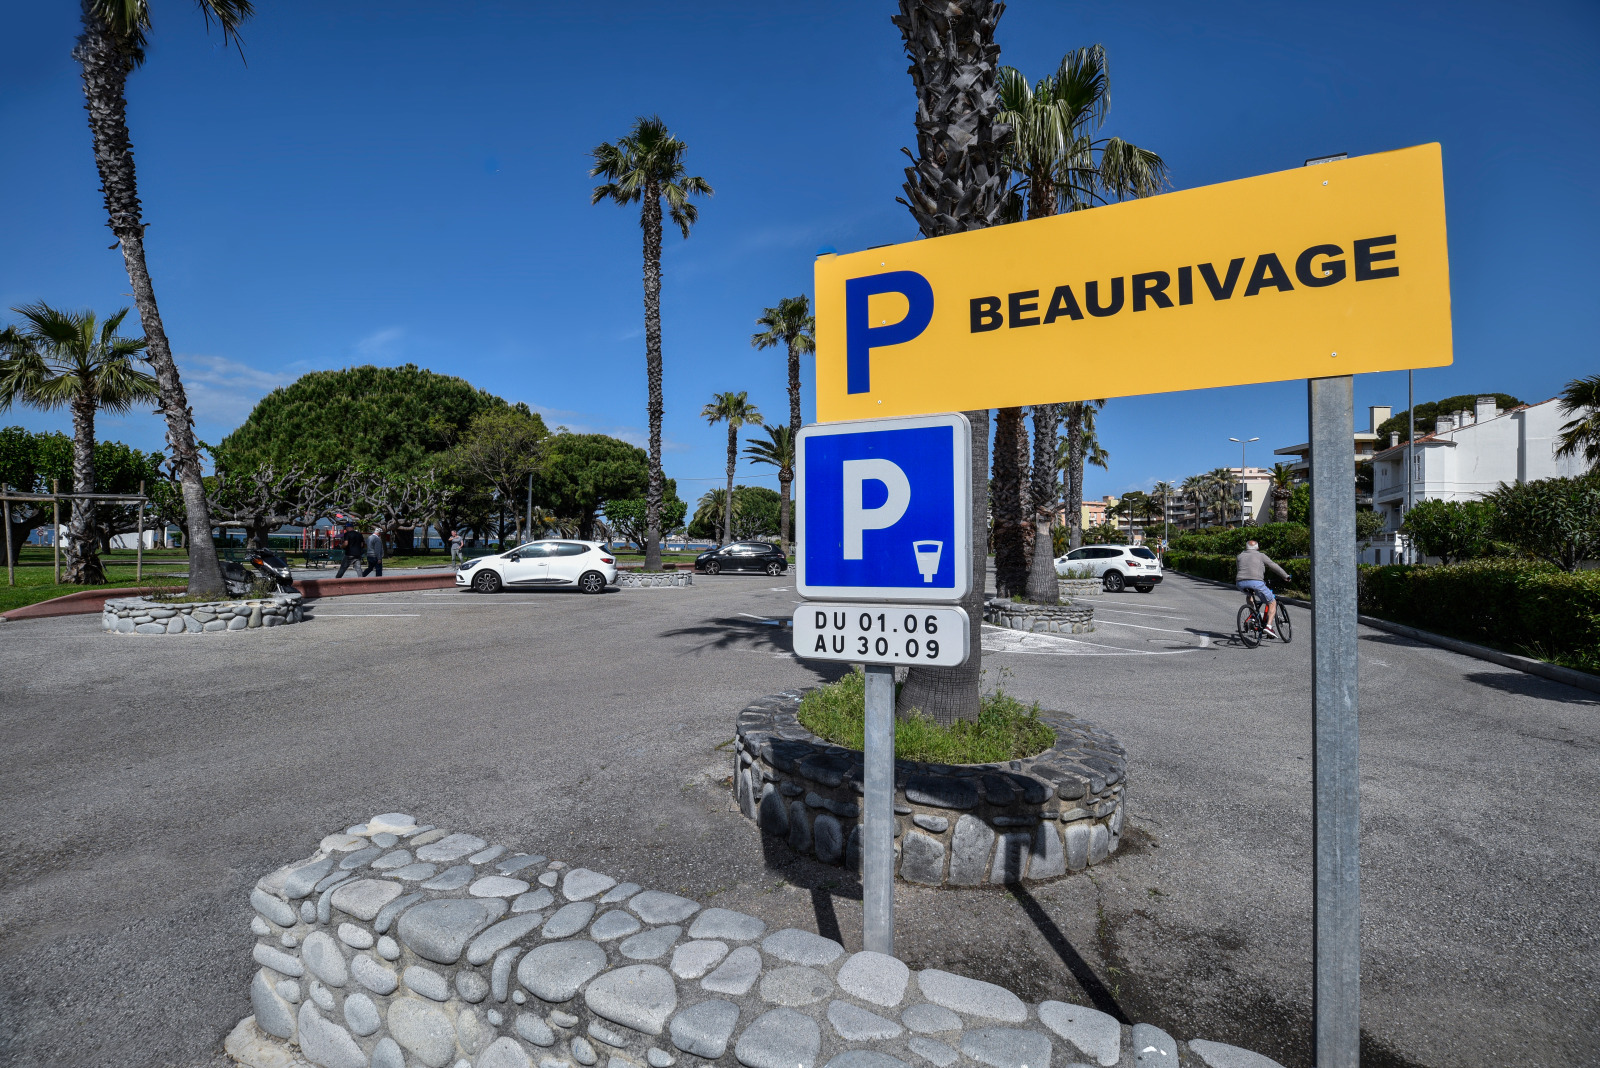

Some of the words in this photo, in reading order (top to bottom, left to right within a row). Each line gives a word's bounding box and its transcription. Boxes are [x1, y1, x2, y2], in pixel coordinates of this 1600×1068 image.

[845, 270, 935, 395] P
[969, 234, 1400, 334] BEAURIVAGE
[843, 458, 911, 560] P
[814, 634, 845, 653] AU
[857, 636, 940, 659] 30.09
[815, 611, 846, 630] DU
[859, 612, 938, 634] 01.06
